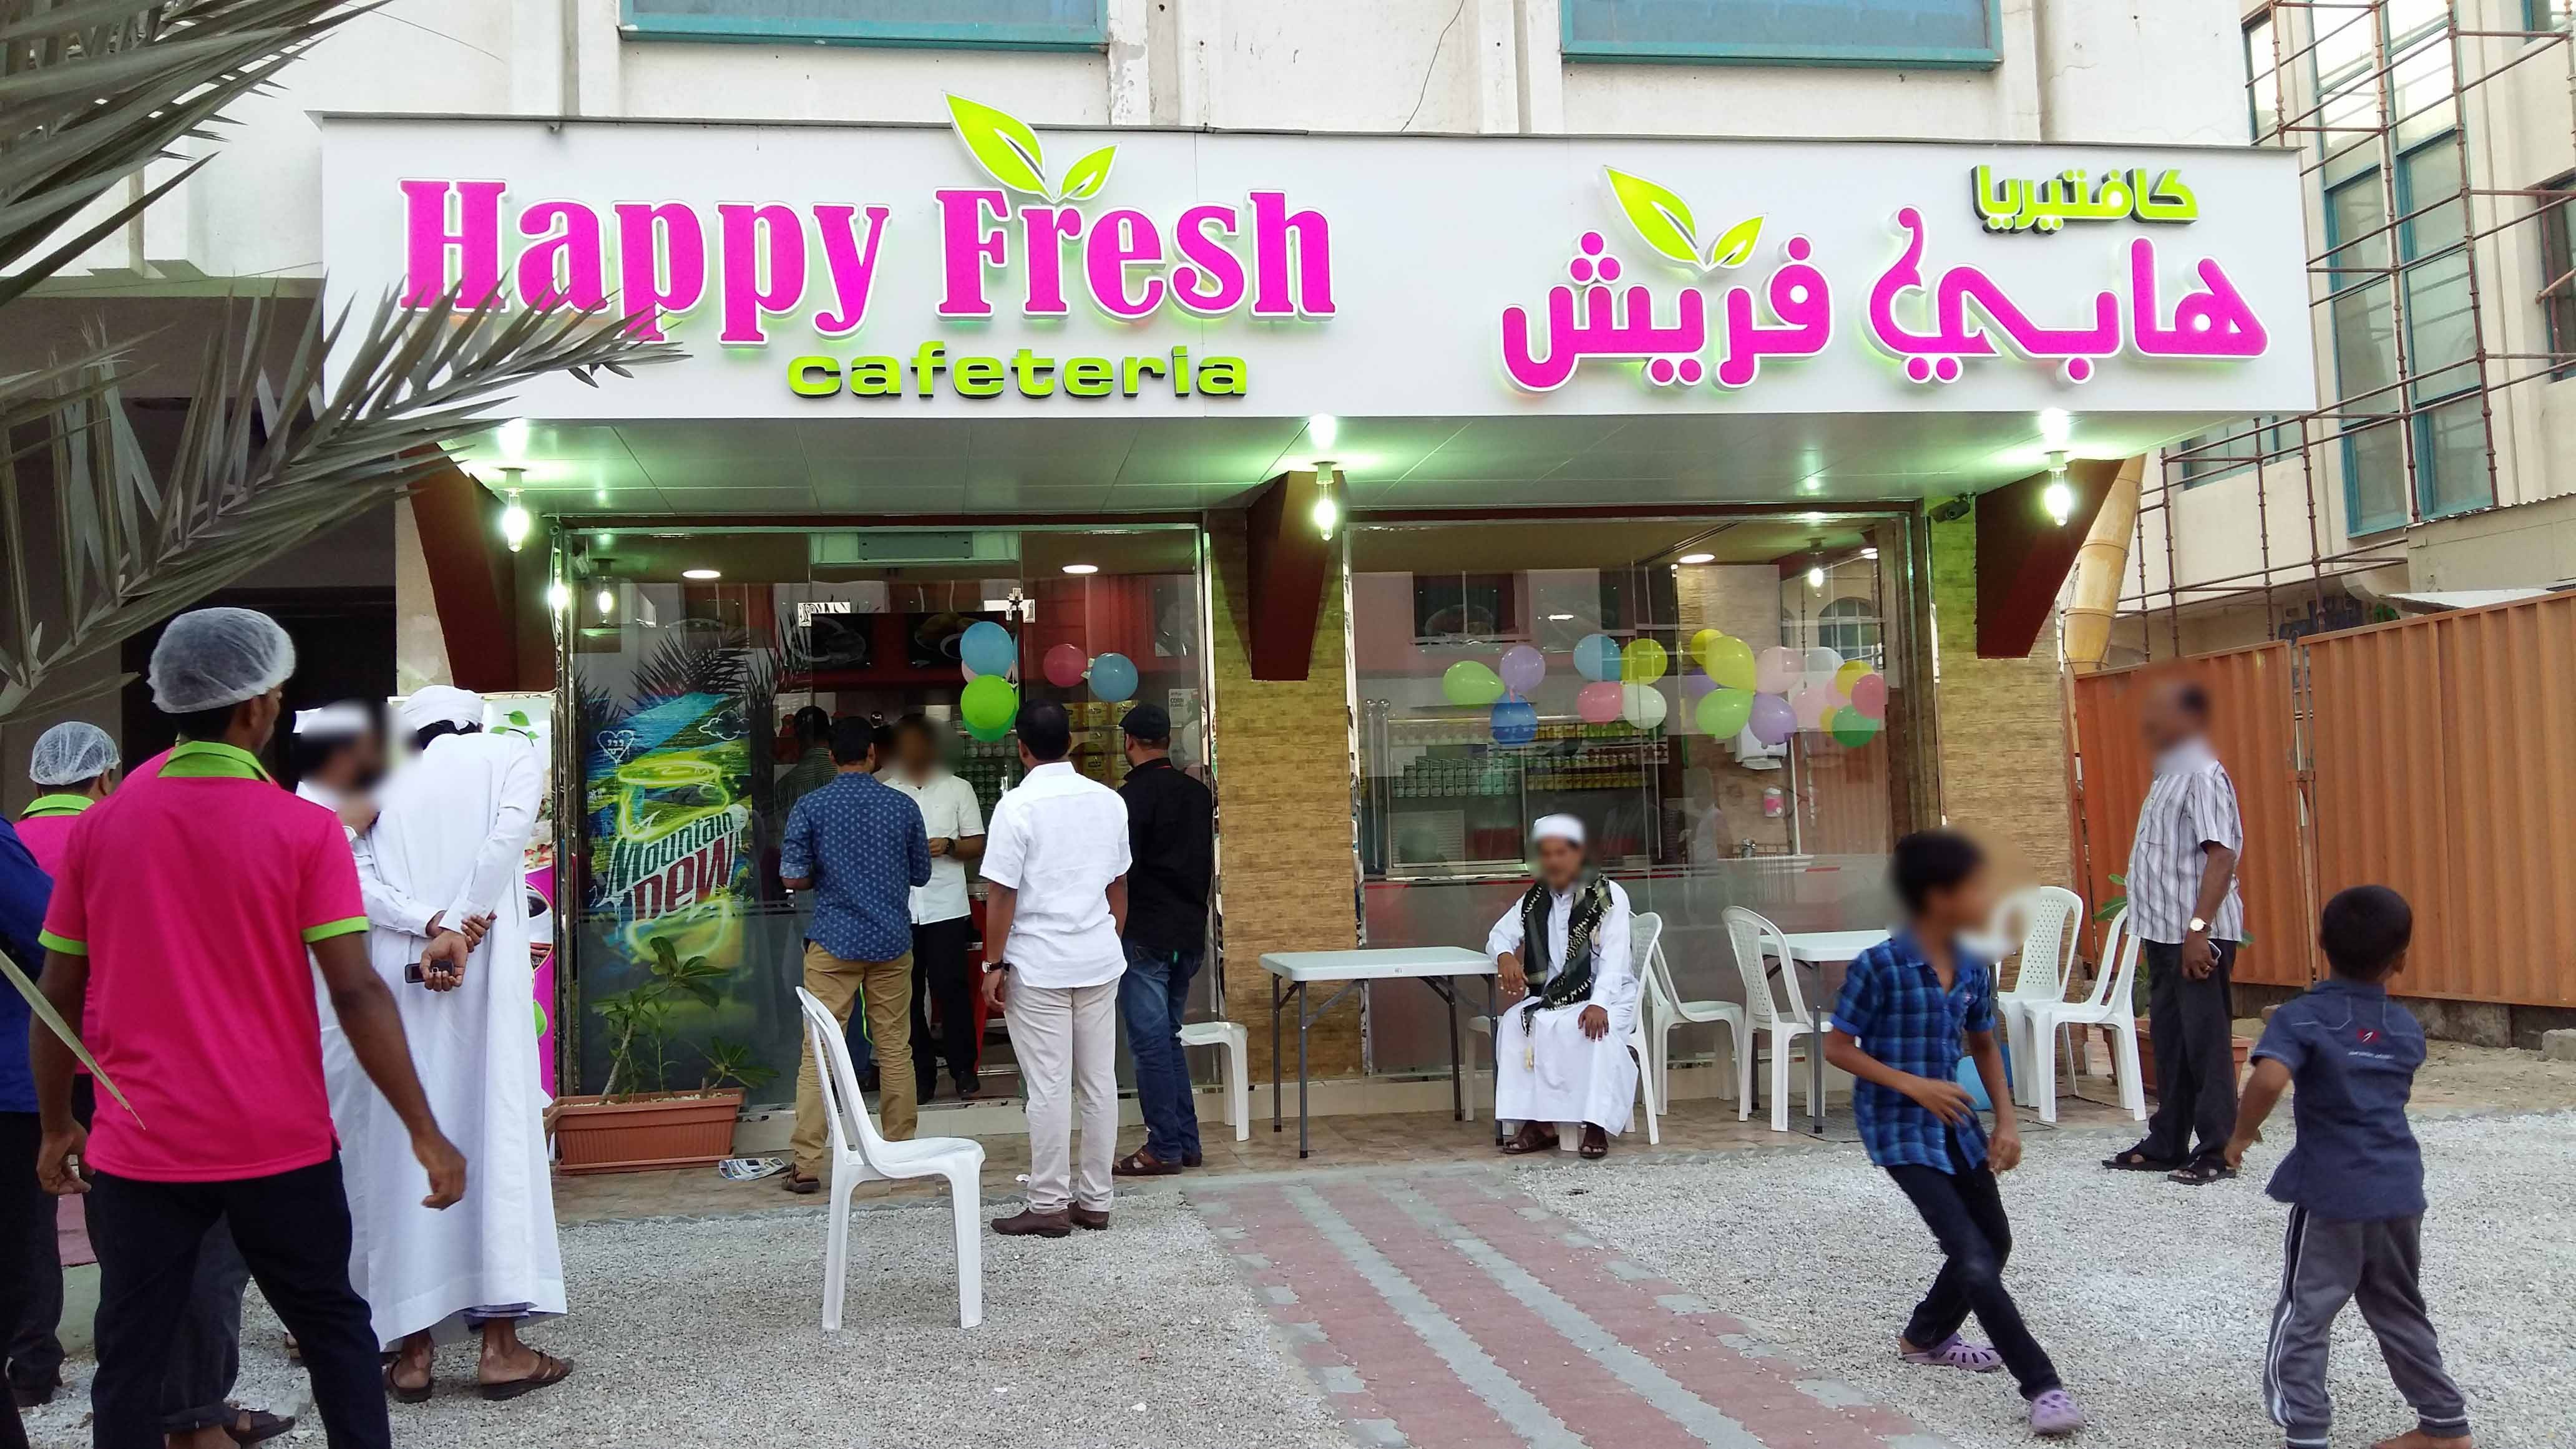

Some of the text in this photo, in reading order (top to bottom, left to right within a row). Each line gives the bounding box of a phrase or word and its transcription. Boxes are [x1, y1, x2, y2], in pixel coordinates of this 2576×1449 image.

[1972, 164, 2200, 231] كافتيريا
[399, 180, 1337, 344] Happy Fresh
[1500, 207, 2268, 390] هابي فريش
[787, 341, 1248, 399] cafeteria
[607, 811, 734, 897] Mountain
